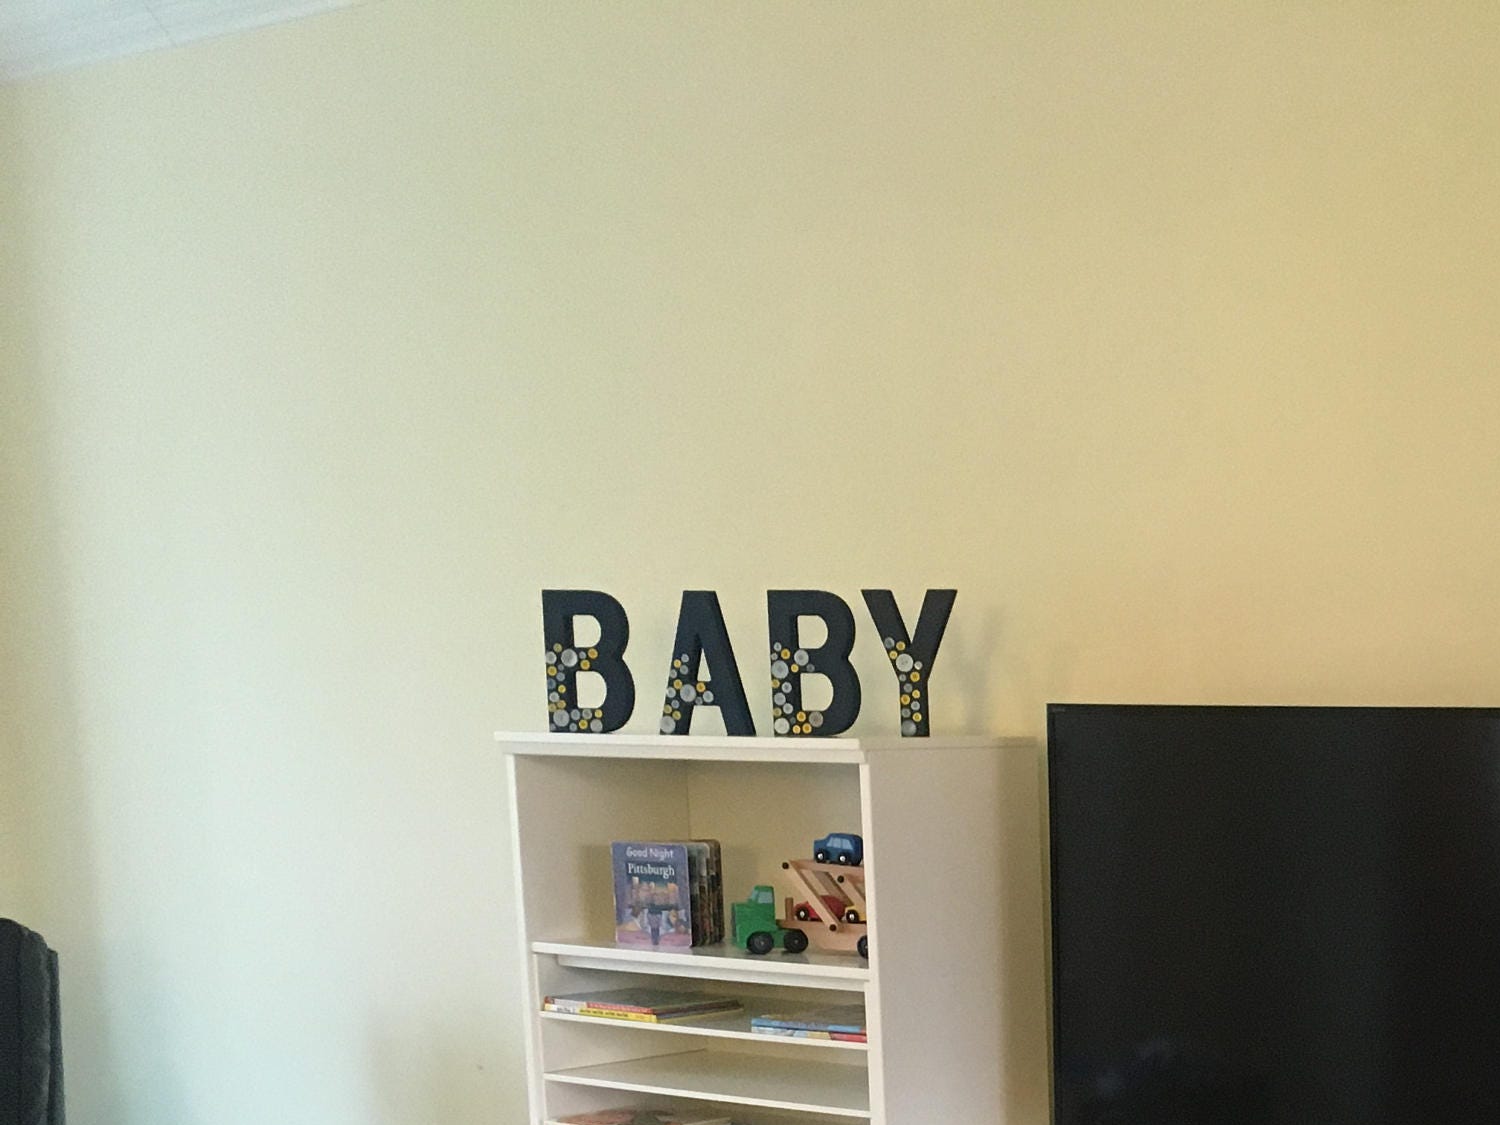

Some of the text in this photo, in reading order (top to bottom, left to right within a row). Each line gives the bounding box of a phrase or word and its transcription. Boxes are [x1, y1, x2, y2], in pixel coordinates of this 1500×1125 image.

[541, 589, 958, 737] BABY
[626, 847, 674, 859] Good Night
[627, 863, 675, 879] Pittsburgh
